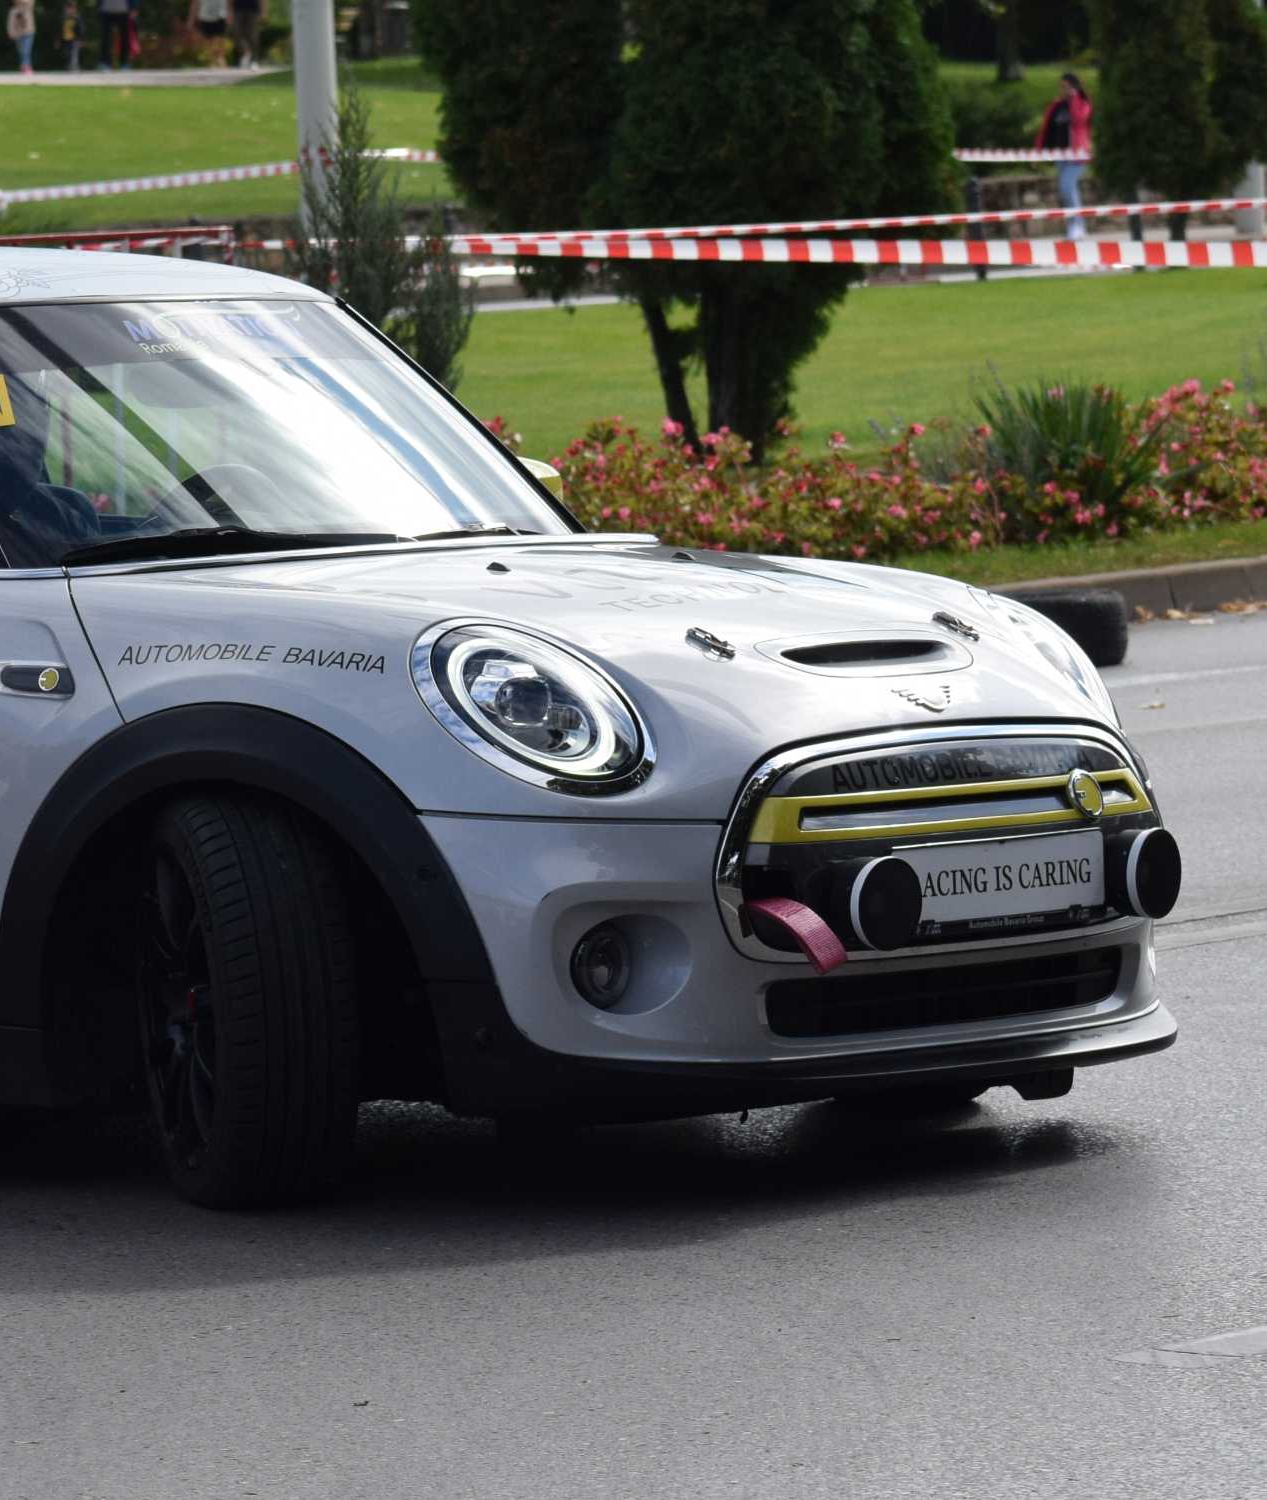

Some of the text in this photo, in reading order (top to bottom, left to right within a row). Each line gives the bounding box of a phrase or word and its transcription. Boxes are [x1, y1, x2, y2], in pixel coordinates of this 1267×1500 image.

[118, 643, 385, 674] AUTOMOBILE BAVARIA
[921, 857, 1092, 898] ACING IS CARING
